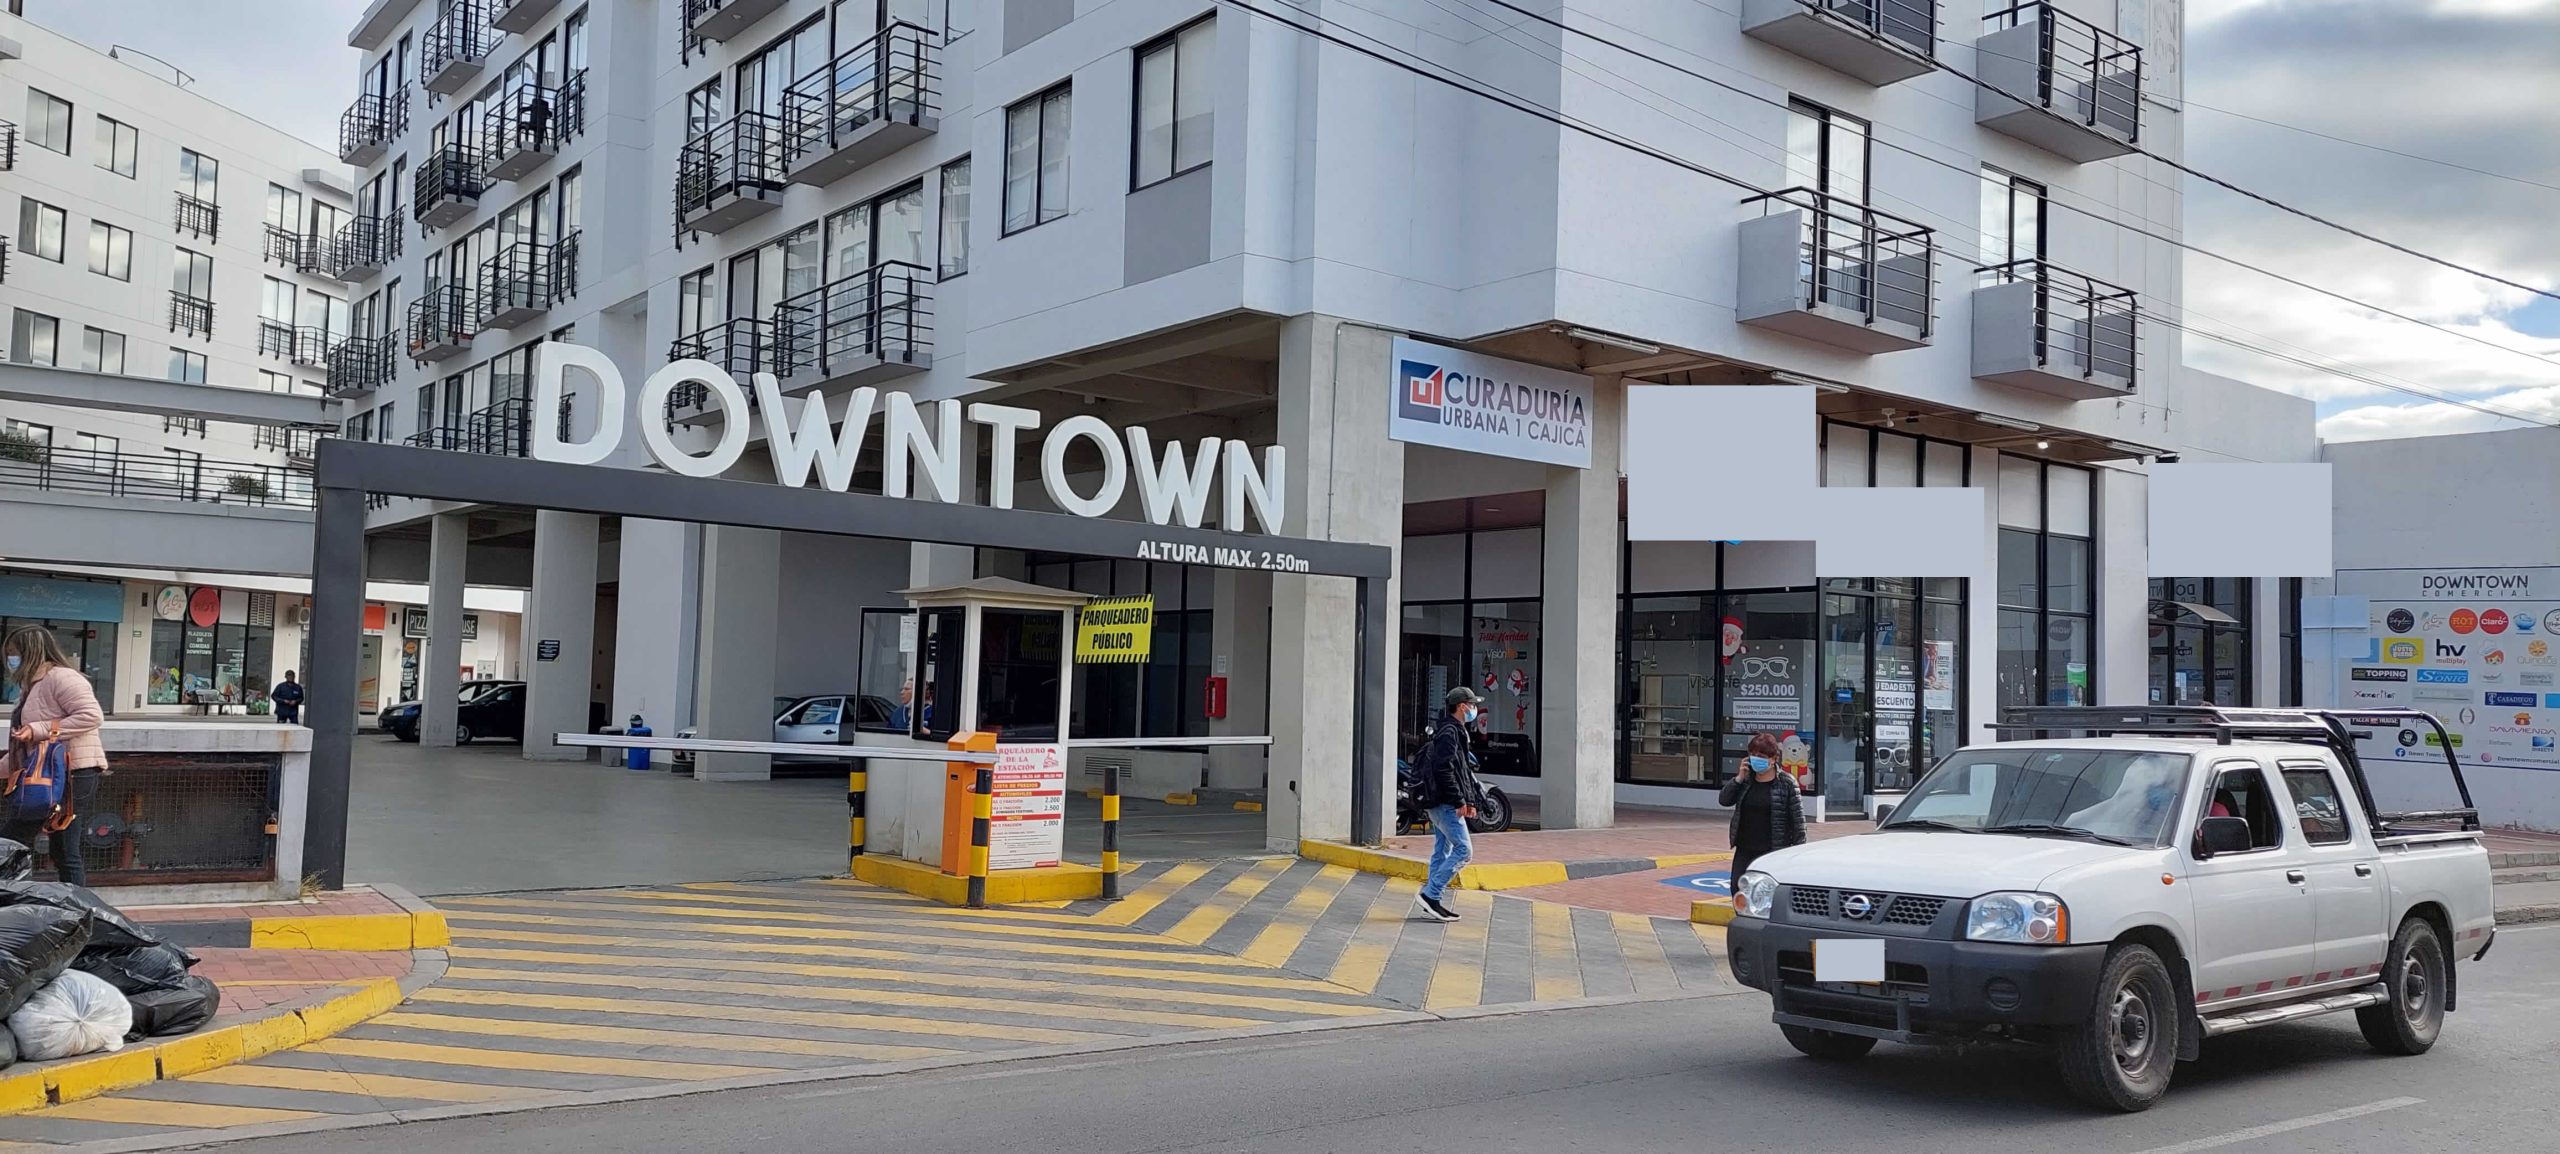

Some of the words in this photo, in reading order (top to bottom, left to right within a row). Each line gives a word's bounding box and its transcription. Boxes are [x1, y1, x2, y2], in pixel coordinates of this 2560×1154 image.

[1444, 371, 1586, 426] CURADURÍA
[1443, 406, 1509, 436] URBANA
[1515, 418, 1522, 437] 1
[1527, 420, 1586, 449] CAJICÁ
[532, 340, 1286, 537] DOWNTOWN
[1136, 540, 1209, 564] ALTURA
[1213, 547, 1256, 568] MAX.
[1260, 551, 1310, 573] 2.50m
[2422, 575, 2529, 589] DOWNTOWN
[2422, 589, 2531, 597] COMERCIAL
[409, 614, 428, 630] PIZZ
[1082, 606, 1149, 626] PARQUEADERO
[461, 619, 476, 634] USE
[1092, 630, 1133, 650] PÚBLICO
[2436, 638, 2466, 656] hv
[2435, 657, 2467, 665] multiplay
[2366, 670, 2407, 678] TOPPING
[1740, 684, 1795, 696] $250.000
[1880, 682, 1899, 690] EDAD
[1899, 683, 1906, 691] ES
[1906, 683, 1915, 691] TU
[1876, 696, 1915, 706] ESCUENTO
[2489, 726, 2557, 735] DAVIVIENDA
